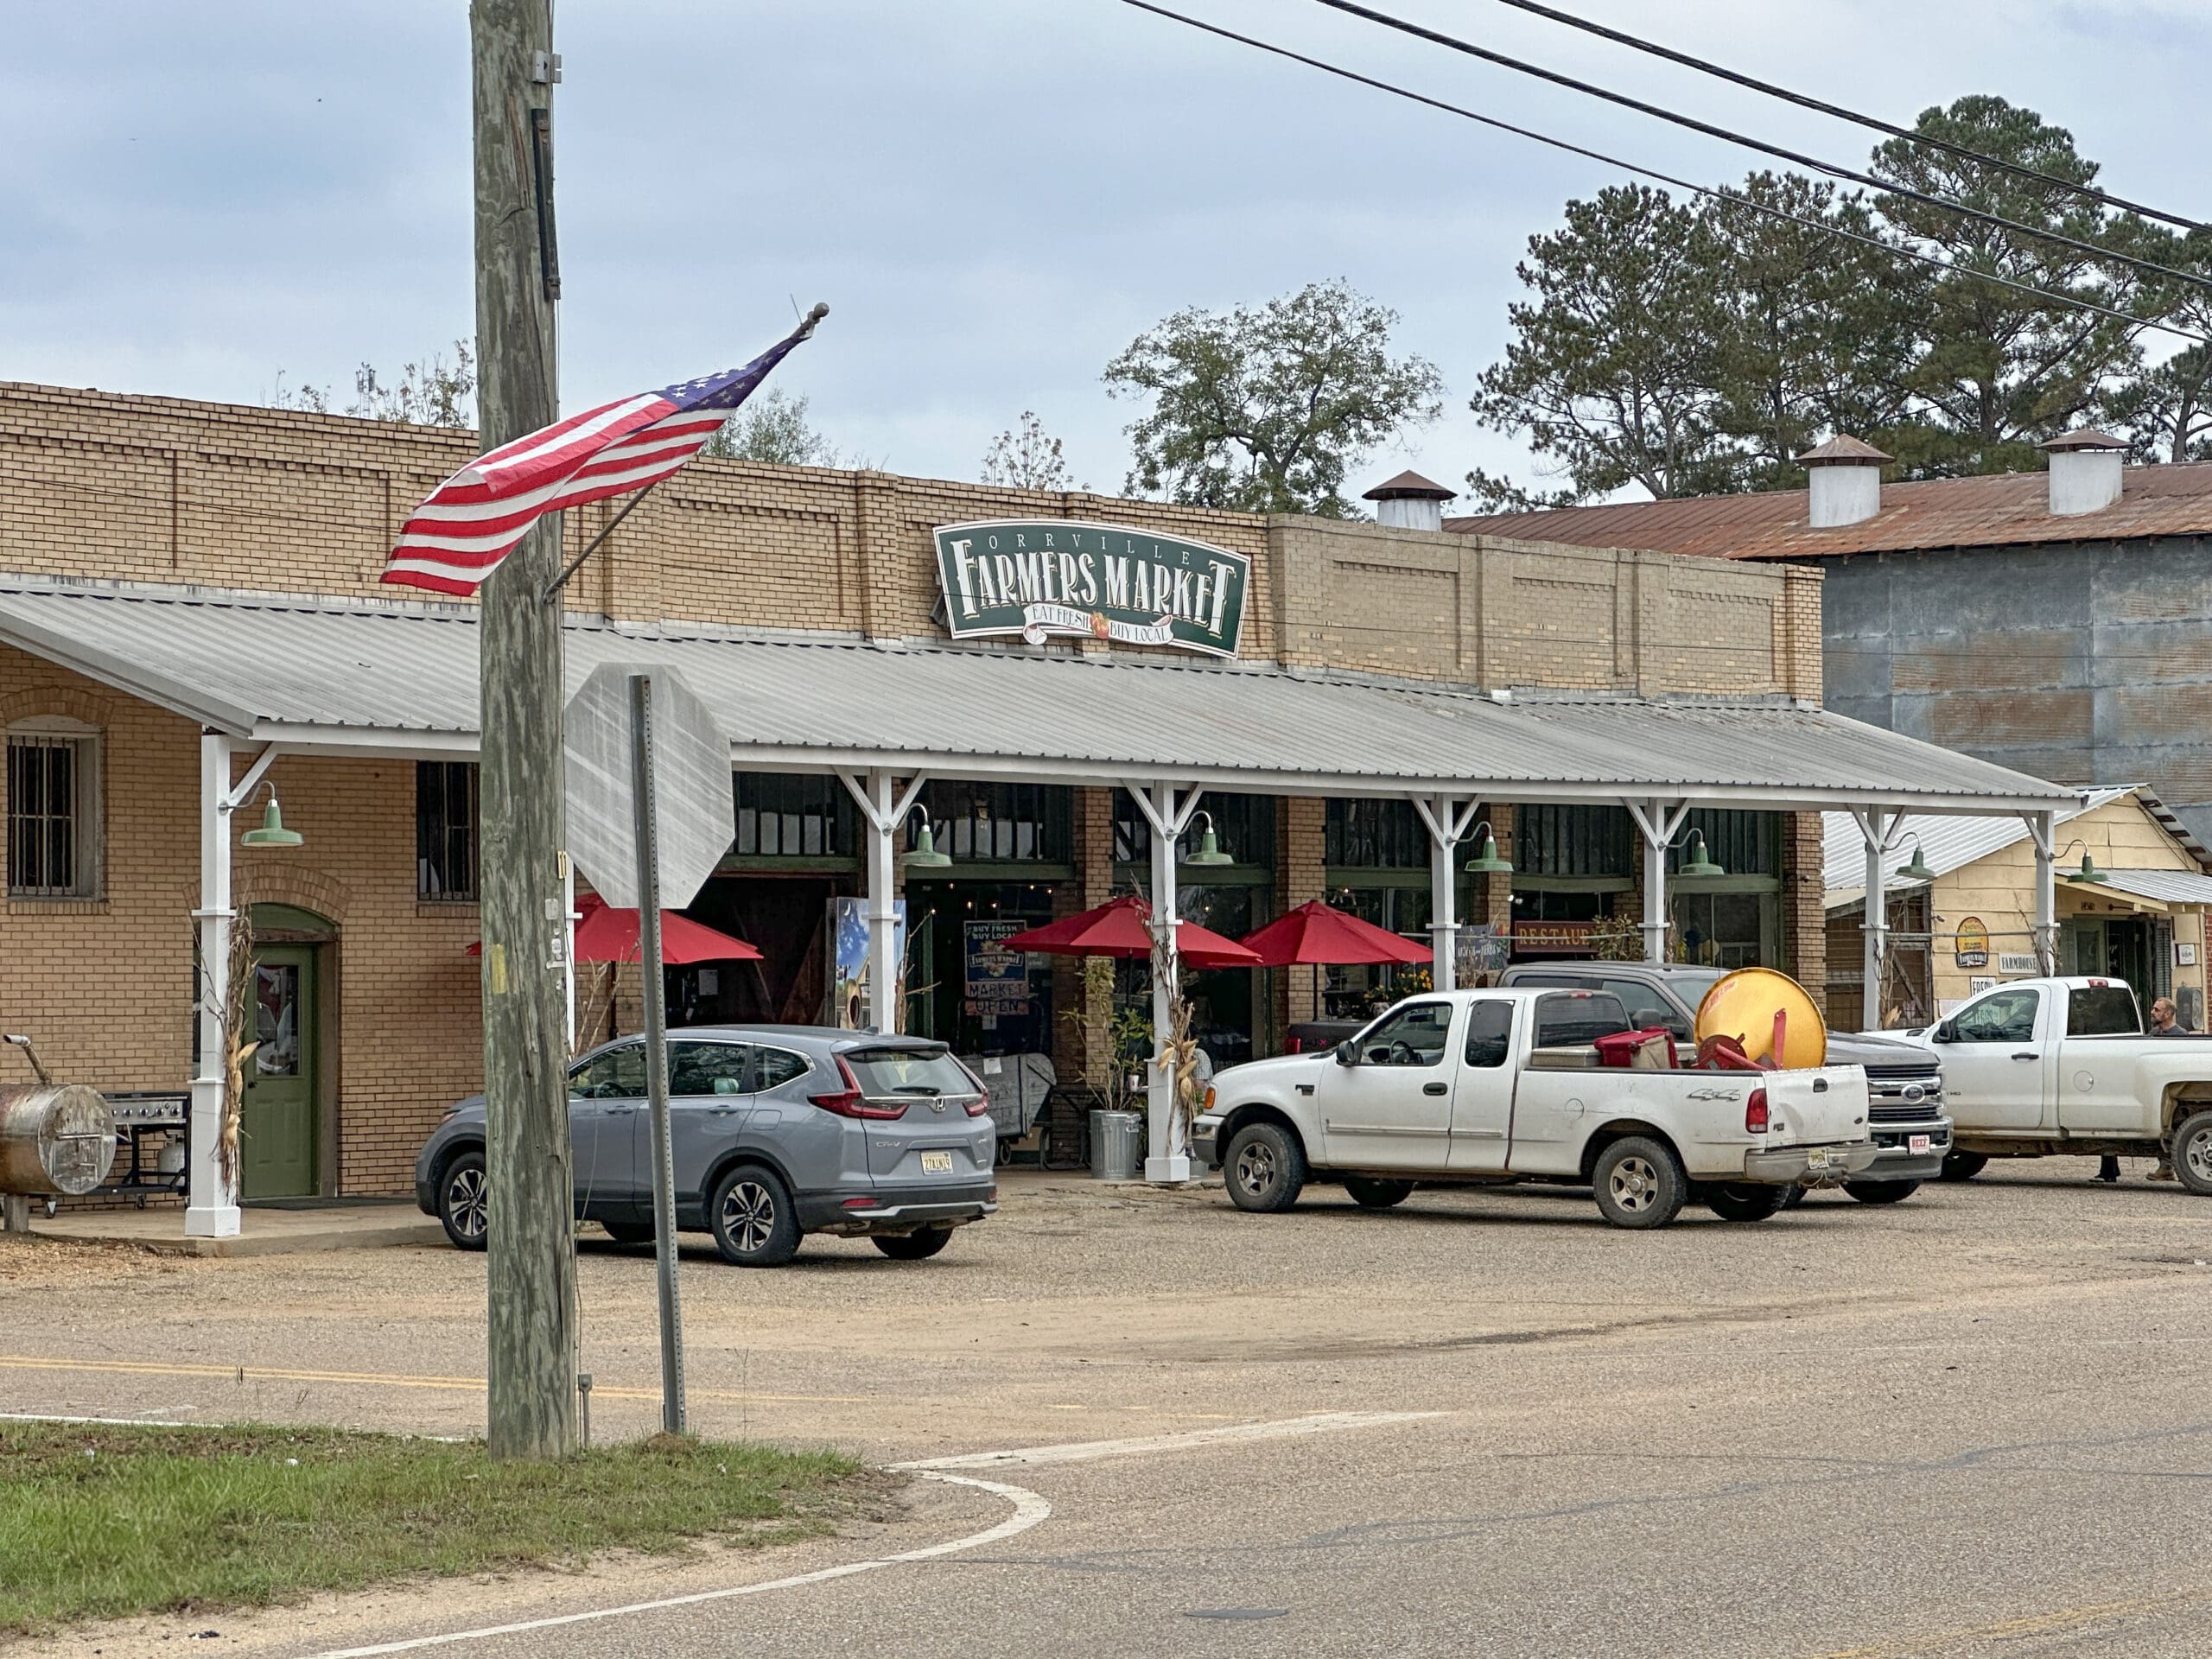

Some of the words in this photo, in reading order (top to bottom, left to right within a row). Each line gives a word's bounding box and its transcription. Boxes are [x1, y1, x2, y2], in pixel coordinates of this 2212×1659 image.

[988, 533, 1190, 565] ORRVILLE
[950, 538, 1098, 620] FARMERS
[1104, 554, 1237, 639] MARKET
[1033, 606, 1053, 620] EAT
[1057, 608, 1089, 630] FRESH
[1110, 621, 1132, 639] BUY
[1135, 626, 1168, 642] LOCAL
[969, 983, 1024, 997] MARKET
[976, 1001, 1019, 1013] OPEN
